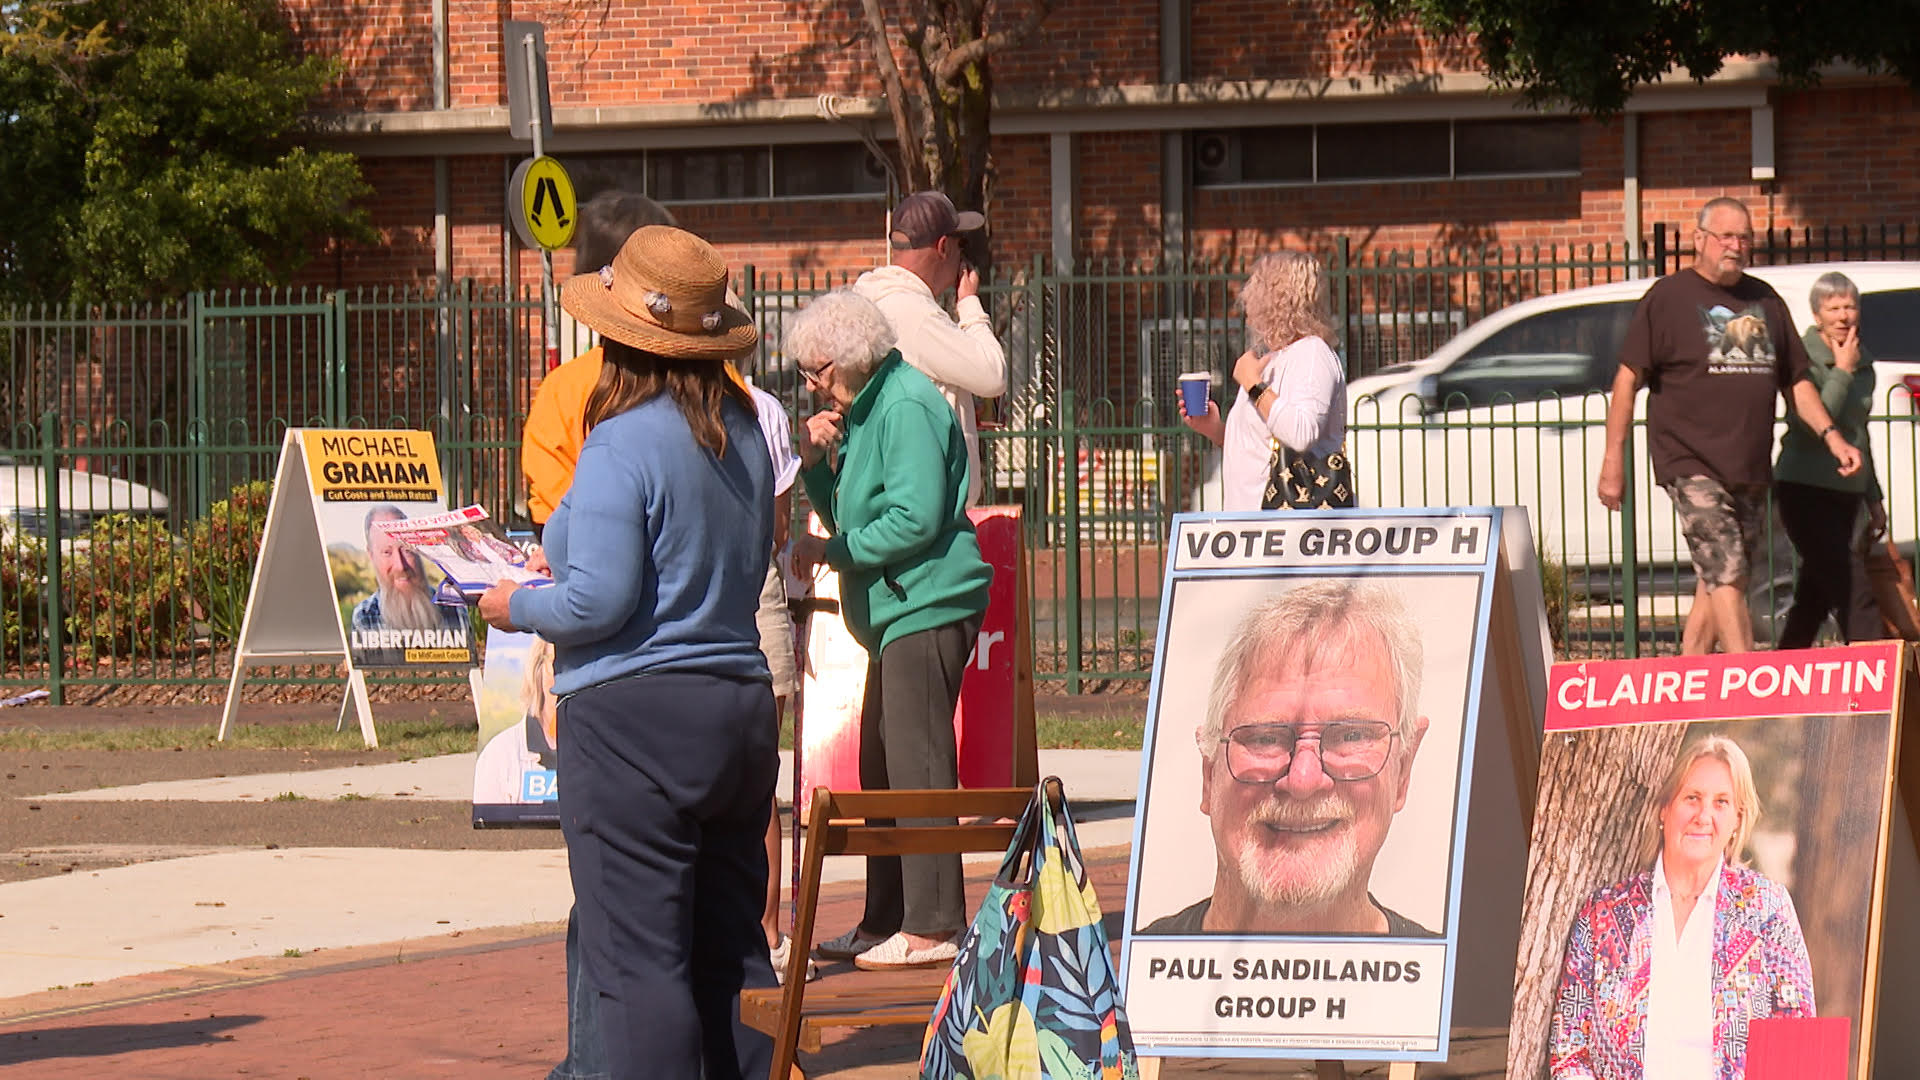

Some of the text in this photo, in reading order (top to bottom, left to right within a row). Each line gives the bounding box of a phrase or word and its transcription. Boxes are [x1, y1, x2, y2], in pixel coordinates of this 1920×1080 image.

[322, 437, 418, 458] MICHAEL
[323, 461, 430, 485] GRAHAM
[328, 491, 344, 500] Cut
[345, 491, 368, 500] Costs
[369, 491, 385, 500] and
[386, 491, 408, 500] Slash
[1187, 526, 1478, 559] VOTE GROUP H
[351, 629, 467, 648] LIBERTARIAN
[1557, 659, 1887, 711] CLAIRE PONTIN
[1149, 958, 1421, 983] PAUL SANDILANDS
[1215, 995, 1346, 1019] GROUP H
